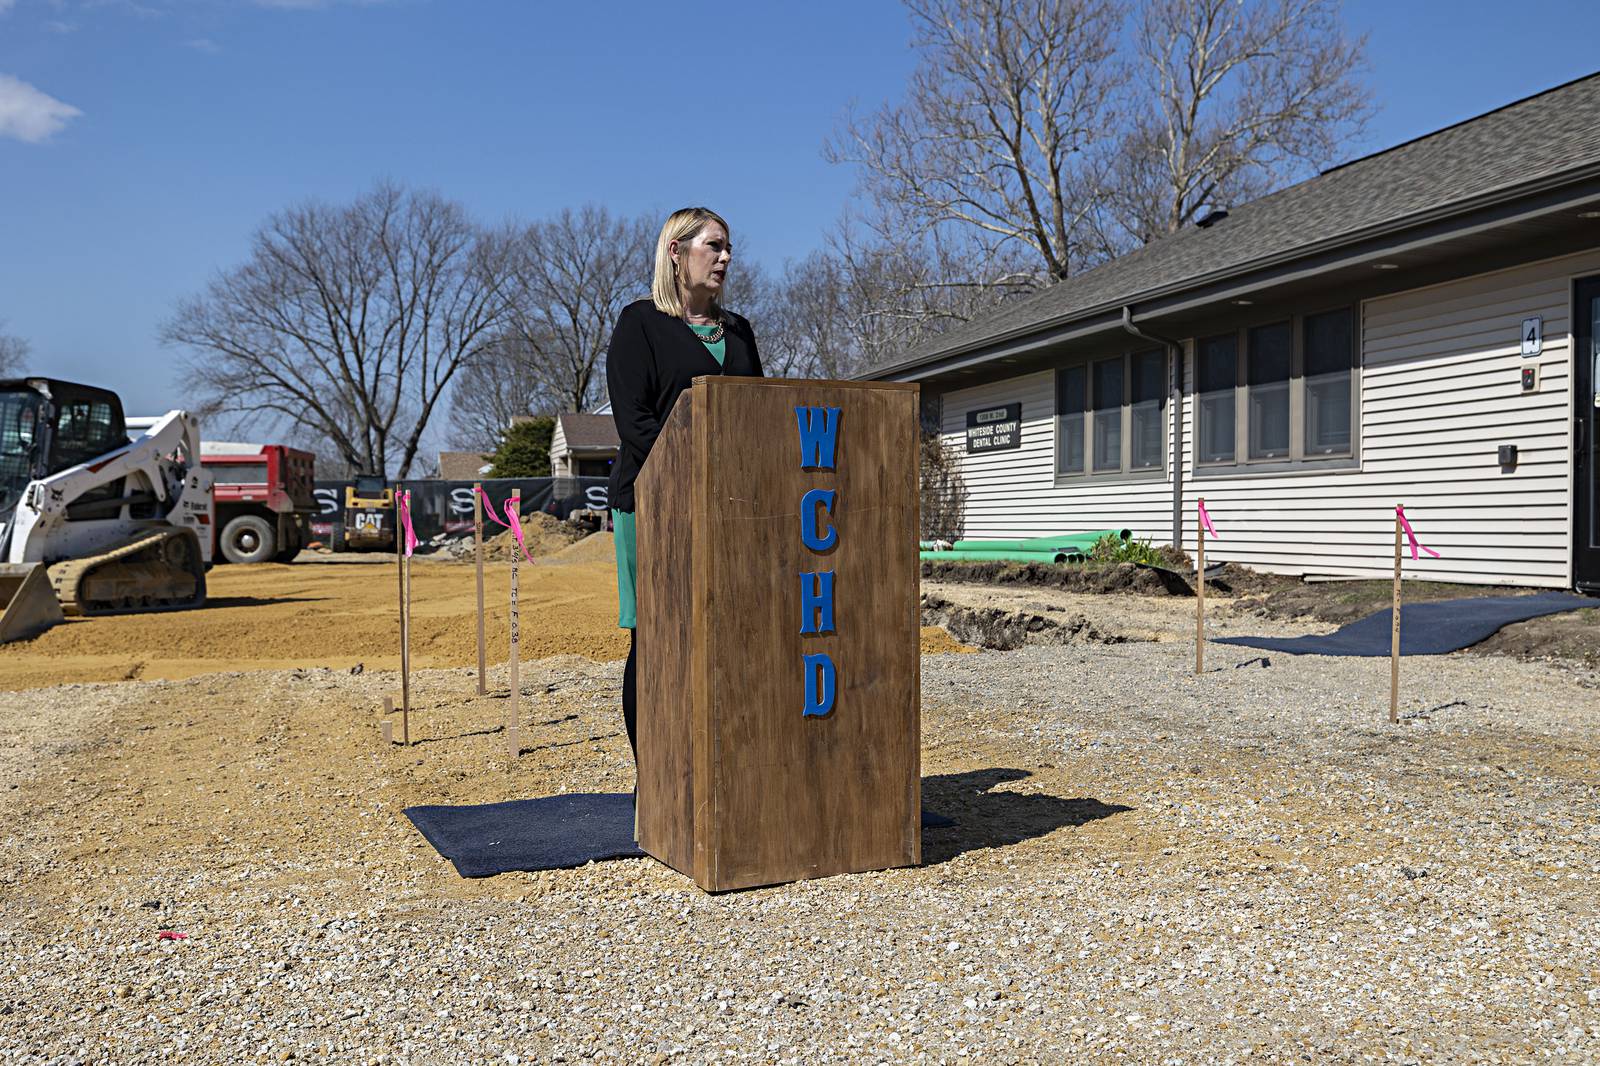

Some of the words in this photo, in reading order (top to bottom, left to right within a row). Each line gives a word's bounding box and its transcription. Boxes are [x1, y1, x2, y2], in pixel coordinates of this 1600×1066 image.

[1527, 327, 1536, 345] 4
[968, 426, 993, 437] WHITESIDE
[996, 422, 1016, 434] COUNTY
[973, 437, 992, 448] DENTAL
[993, 434, 1010, 445] CLINIC
[355, 512, 384, 530] CAT
[795, 407, 841, 717] WCHD
